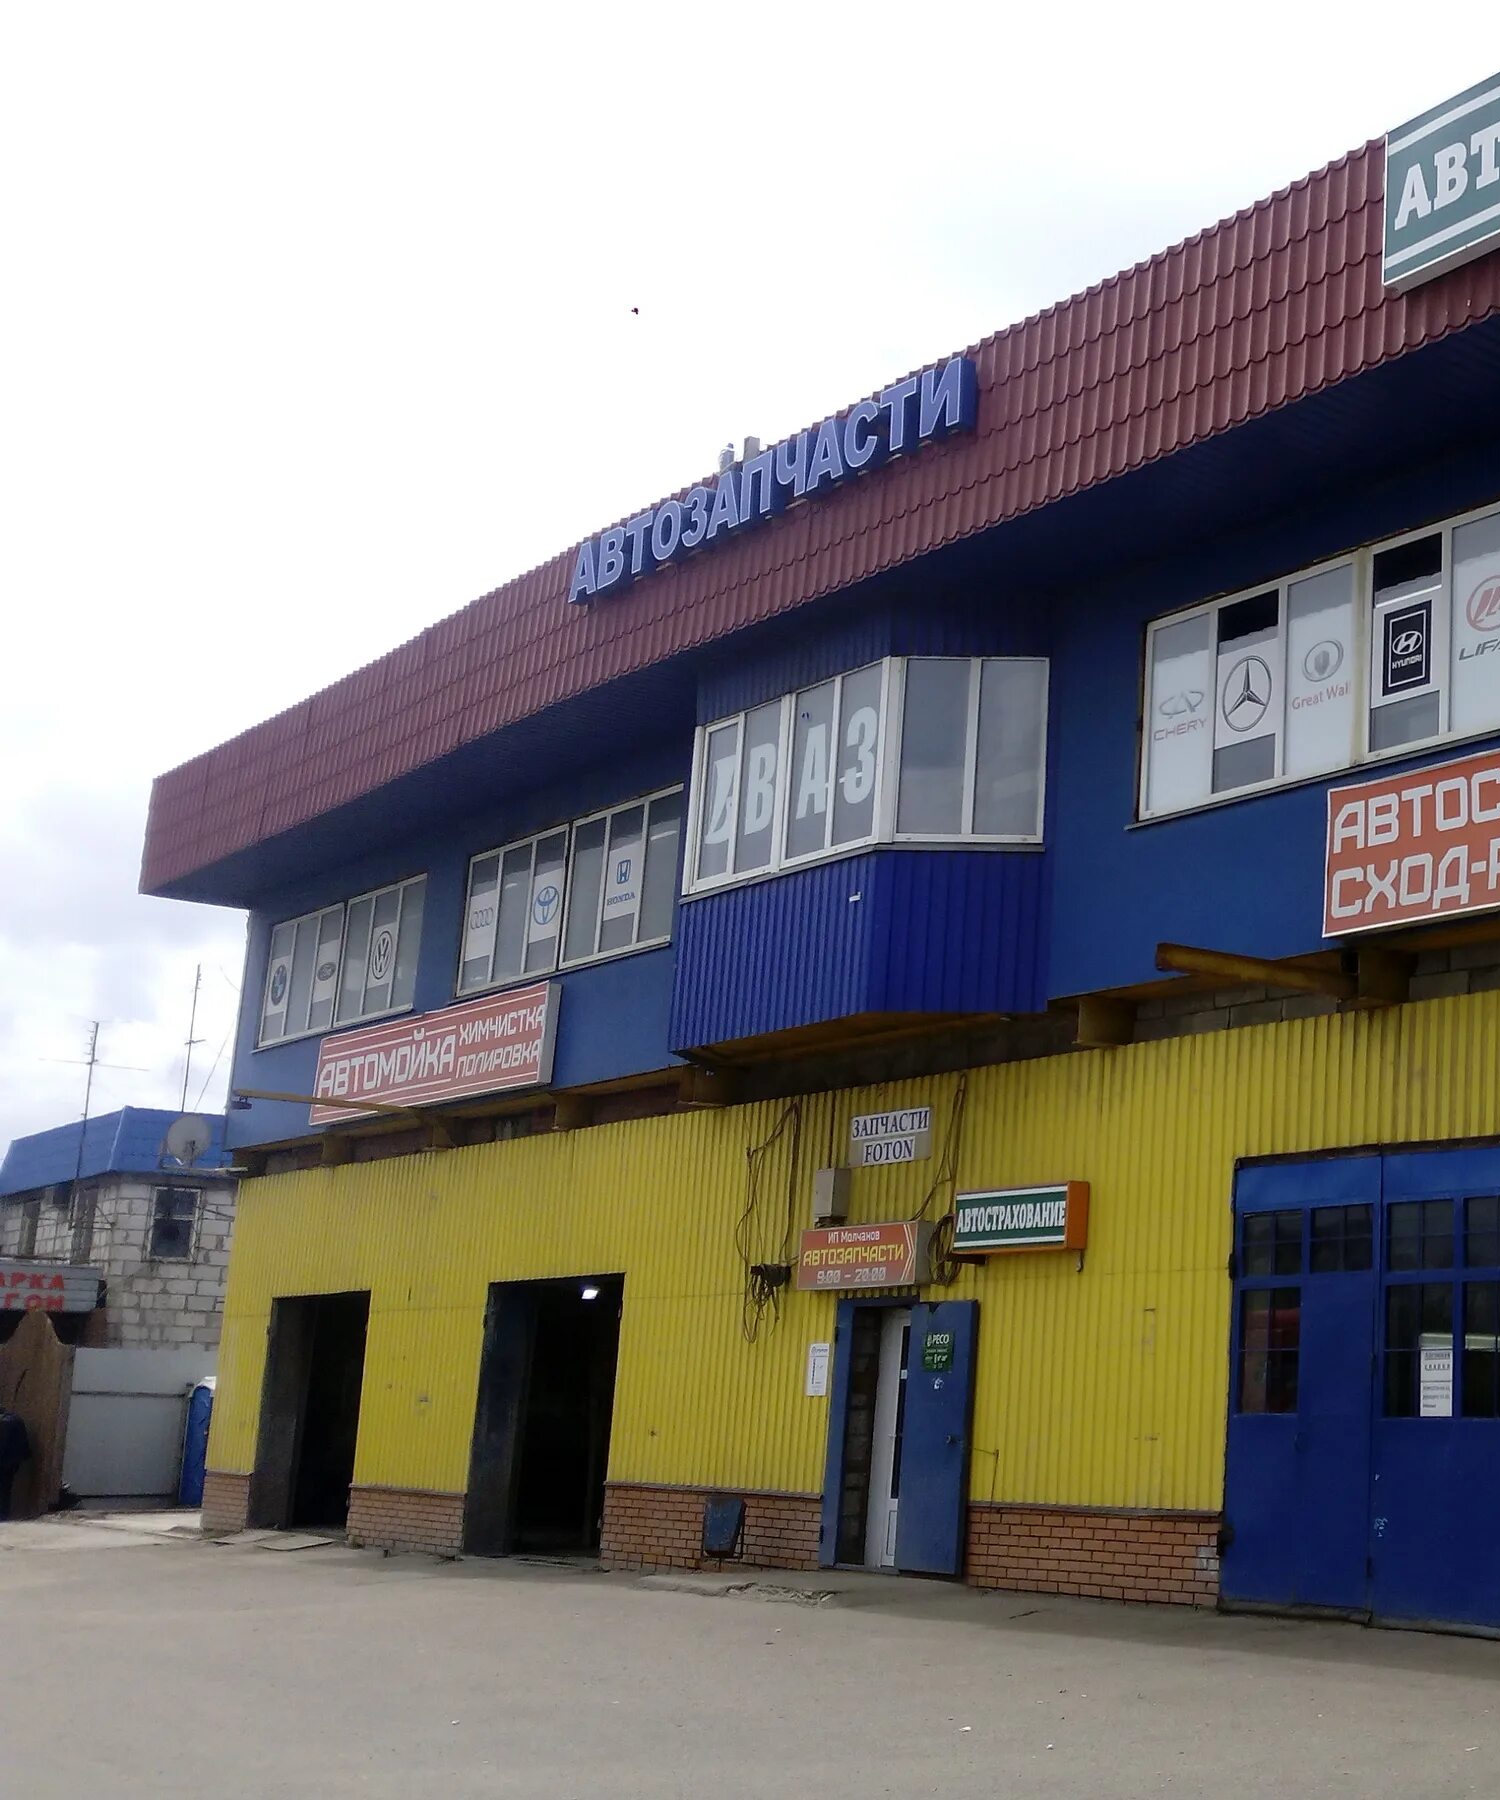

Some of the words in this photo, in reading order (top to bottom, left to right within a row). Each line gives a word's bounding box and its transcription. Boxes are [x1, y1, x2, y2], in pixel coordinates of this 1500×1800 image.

[568, 356, 970, 604] АВТОЗАПЧАСТИ
[1391, 653, 1422, 670] HYUNDAI
[1291, 690, 1324, 711] Great
[1154, 718, 1207, 742] CHERY
[607, 891, 636, 906] HONDA
[459, 1004, 547, 1047] ХИМЧИСТКА
[317, 1028, 457, 1098] АВТОМОЙКА
[456, 1038, 542, 1079] ПОЛИРОВКА
[852, 1110, 928, 1138] ЗАПЧАСТИ
[864, 1139, 914, 1163] FOTON
[956, 1200, 1066, 1234] АВТОСТРАХОВАНИЕ
[828, 1232, 839, 1244] ИП
[841, 1230, 880, 1244] Молчанов
[803, 1243, 904, 1267] АВТОЗАПЧАСТИ
[932, 1334, 950, 1344] РЕСО
